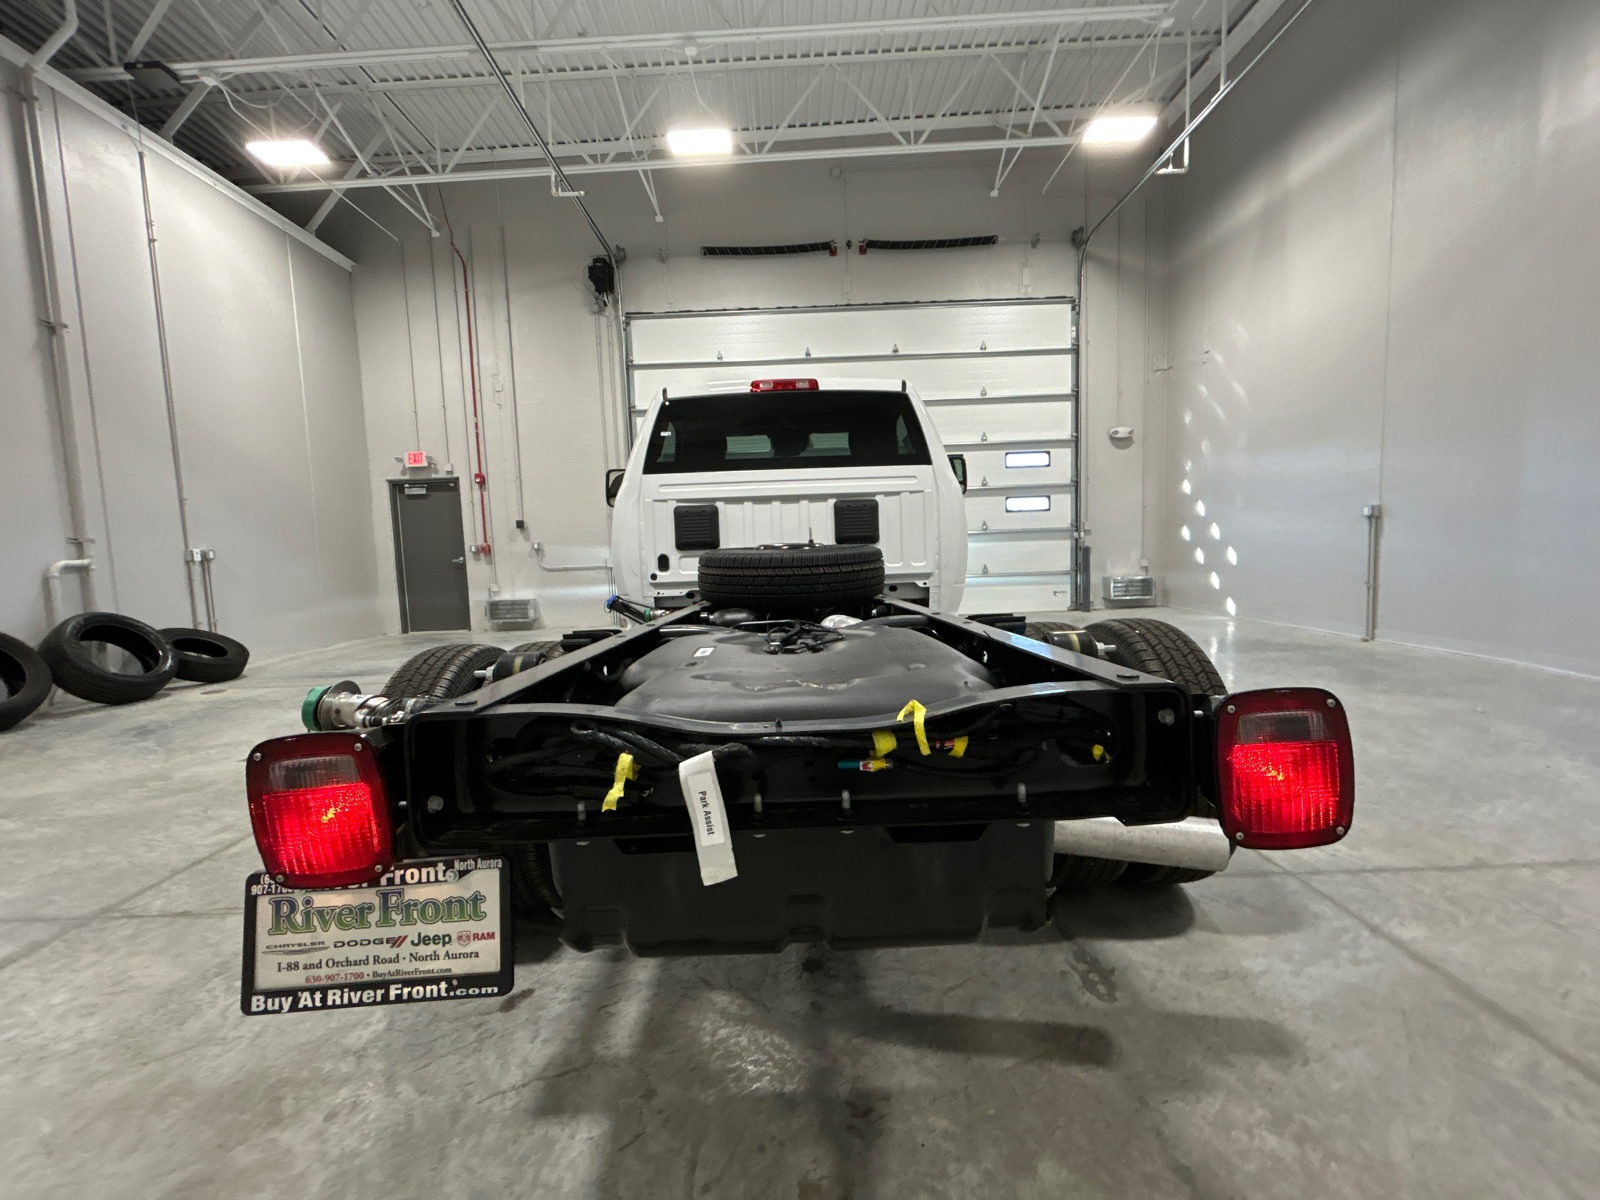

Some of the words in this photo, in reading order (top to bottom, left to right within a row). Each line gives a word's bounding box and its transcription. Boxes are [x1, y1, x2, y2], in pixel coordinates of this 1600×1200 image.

[407, 452, 424, 465] EXIT
[698, 790, 709, 808] Park
[703, 810, 715, 835] Assist
[454, 859, 475, 871] North
[477, 858, 502, 869] Aurora
[333, 937, 396, 948] DODGE
[411, 932, 452, 947] Jeep
[472, 932, 495, 942] RAM
[265, 941, 325, 950] CHRYSLER
[277, 962, 300, 973] I-88
[303, 959, 322, 970] and
[325, 955, 370, 968] Orchard
[372, 954, 400, 965] Road
[408, 950, 440, 963] North
[443, 950, 480, 960] Aurora
[305, 972, 365, 984] 630-907-1700
[372, 968, 452, 979] BuyAtRiverFront.com
[251, 995, 293, 1013] Buy
[298, 991, 322, 1009] At
[327, 988, 385, 1006] River
